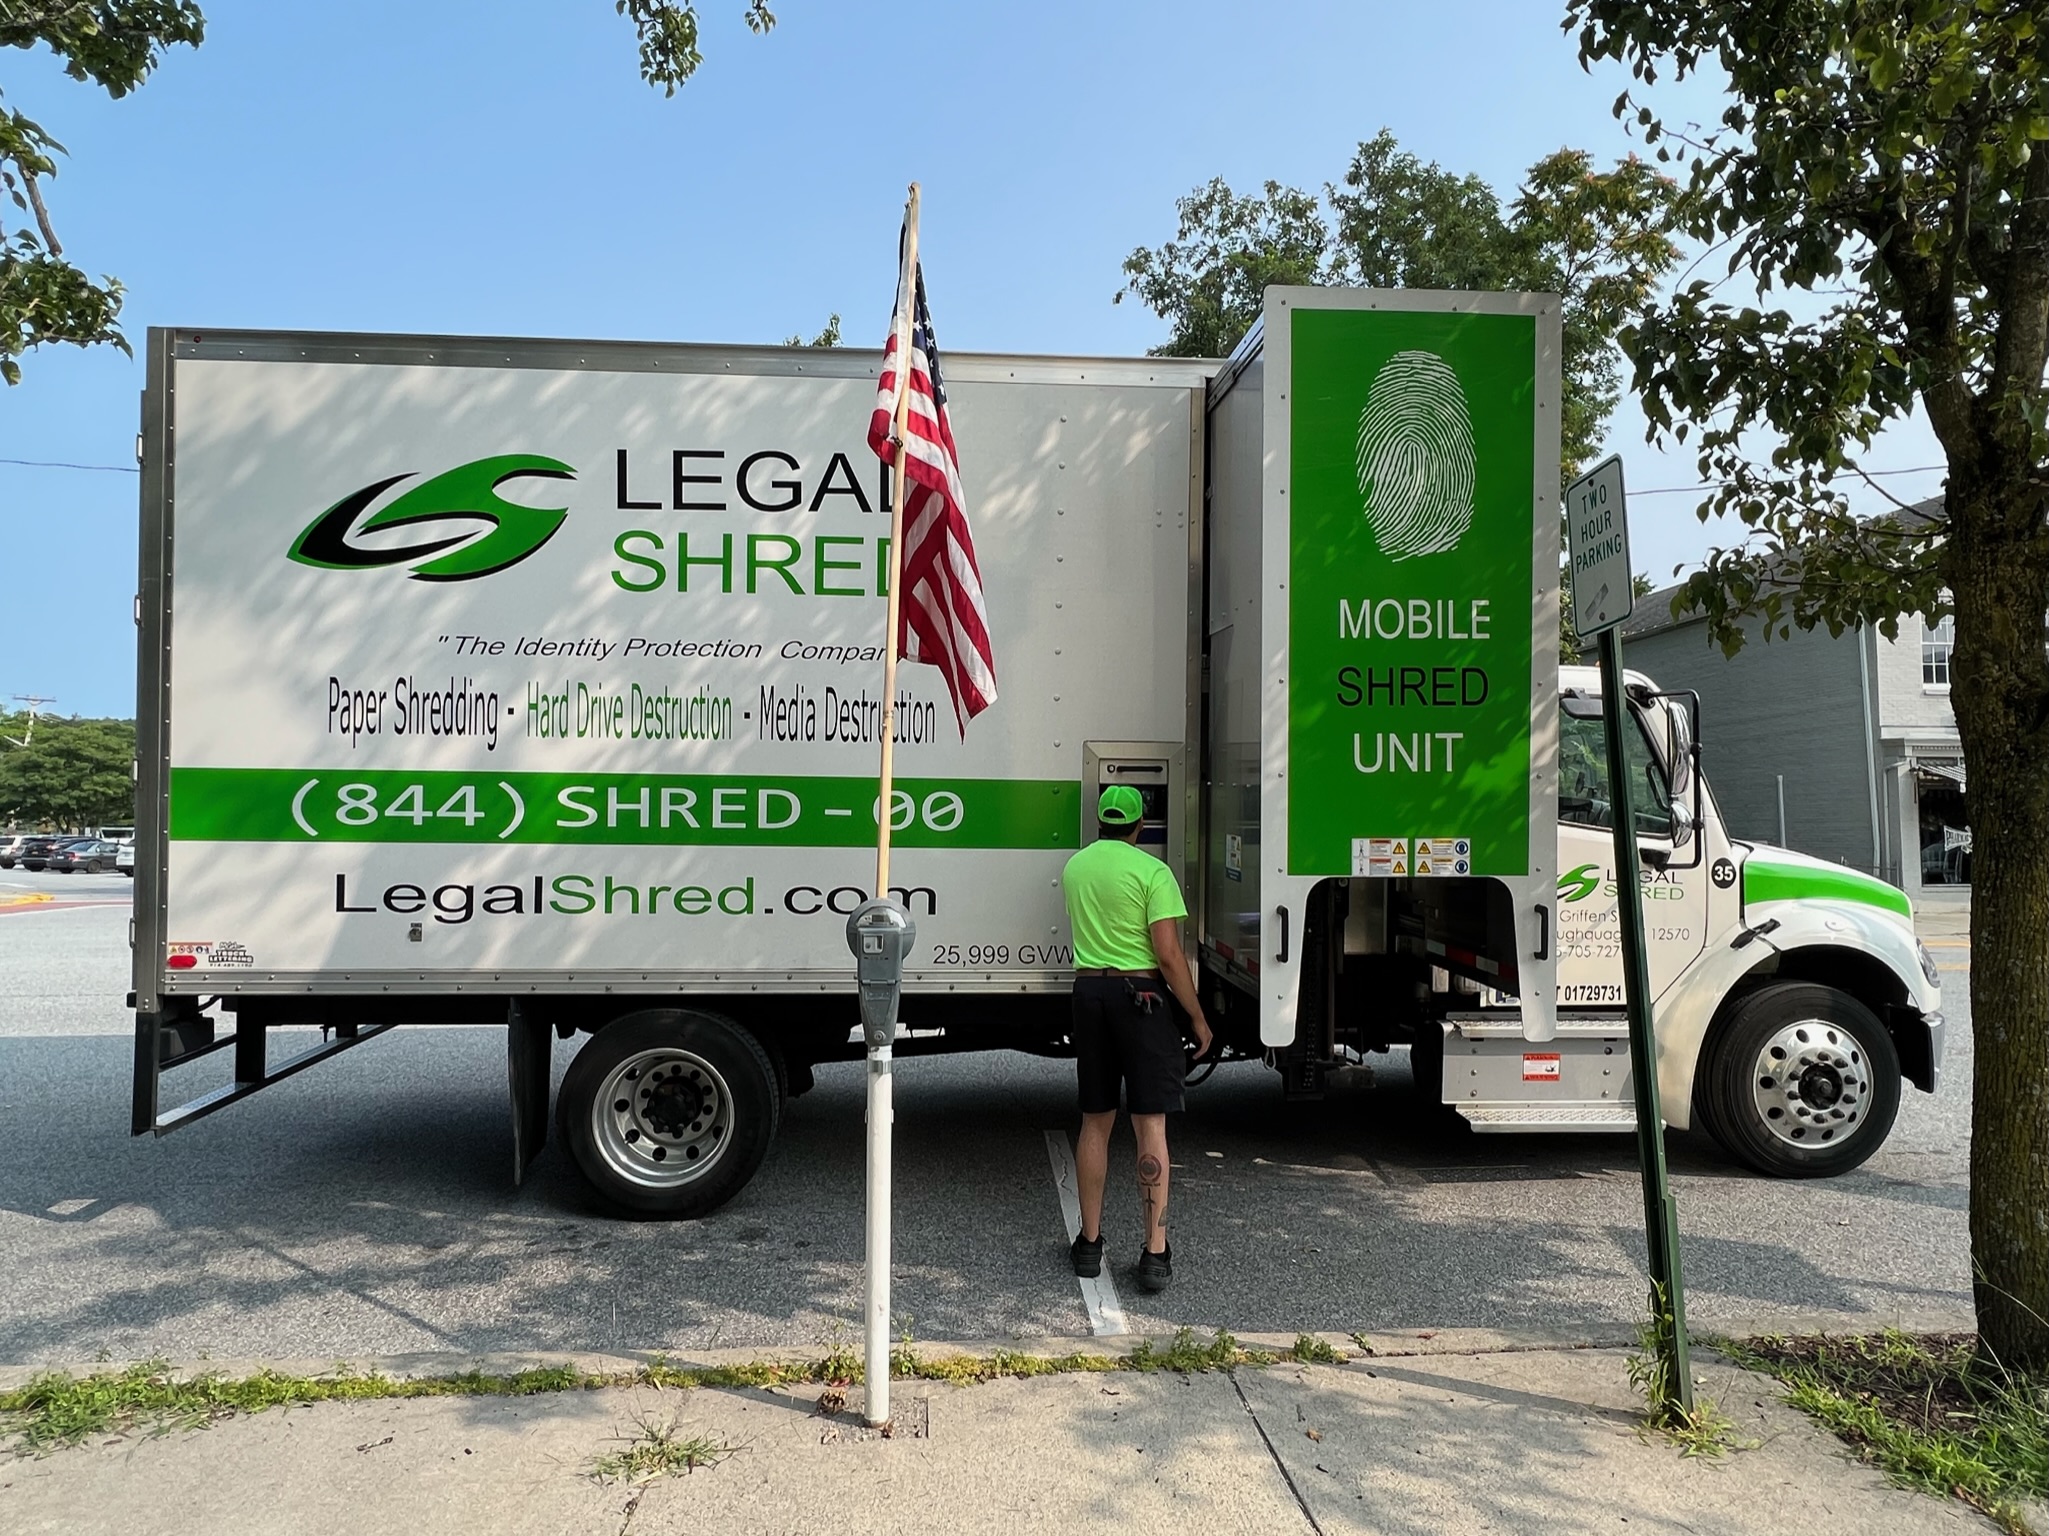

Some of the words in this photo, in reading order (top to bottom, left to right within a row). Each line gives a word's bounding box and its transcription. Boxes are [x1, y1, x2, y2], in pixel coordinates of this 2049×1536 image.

[1581, 484, 1607, 515] TWO
[1580, 510, 1613, 545] HOUR
[1575, 533, 1623, 575] PARKING
[1338, 598, 1491, 640] MOBILE
[514, 637, 618, 662] Identity
[623, 637, 763, 659] Protection
[1336, 665, 1490, 707] SHRED
[328, 675, 387, 749] Paper
[393, 675, 498, 752] Shredding
[527, 679, 569, 739] Hard
[576, 681, 624, 740] Drive
[630, 683, 733, 741] Destruction
[759, 683, 817, 743] Media
[1353, 732, 1464, 774] UNIT
[291, 778, 525, 840] (844)
[556, 784, 801, 830] SHRED
[1606, 869, 1684, 885] LGAL
[1714, 865, 1734, 881] 35
[1603, 884, 1685, 900] SRED
[1559, 909, 1607, 923] Griffen
[1652, 928, 1691, 941] 12570
[933, 944, 1010, 968] 25,999
[1564, 985, 1622, 1001] 01729731
